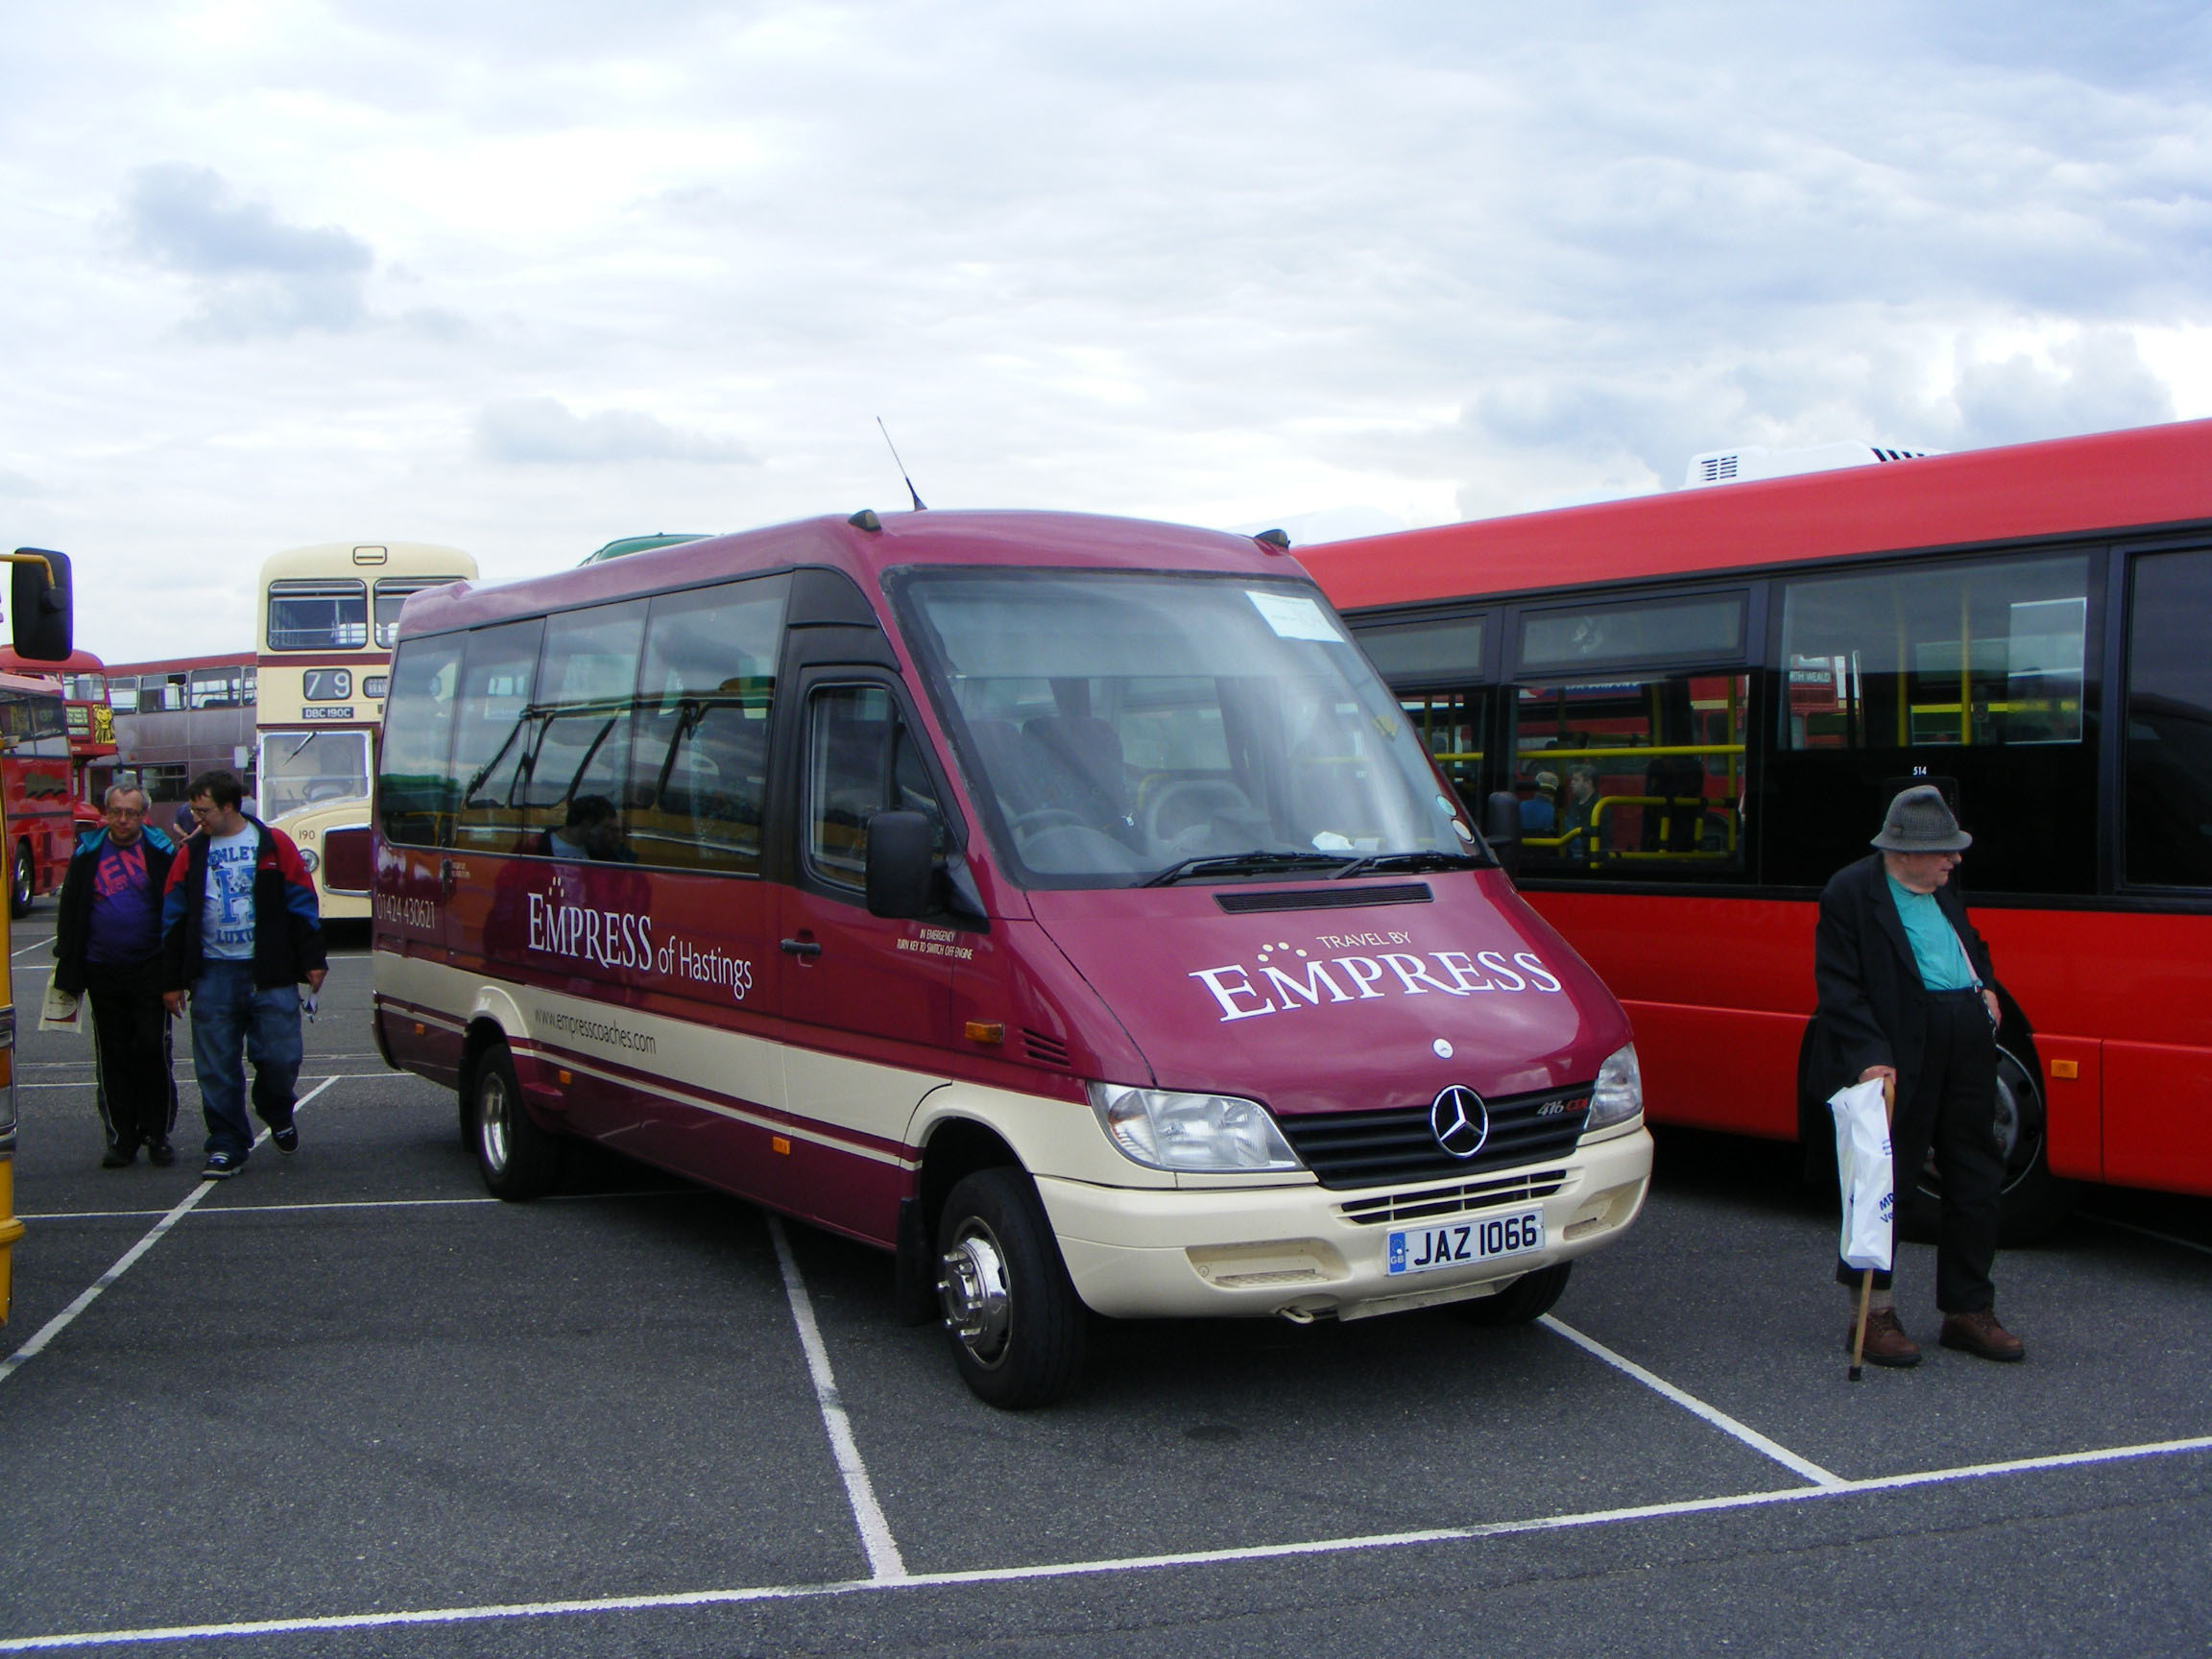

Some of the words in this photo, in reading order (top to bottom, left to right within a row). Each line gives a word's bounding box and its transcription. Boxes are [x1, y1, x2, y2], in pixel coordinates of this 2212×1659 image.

[306, 671, 350, 698] 79
[1912, 766, 1927, 776] 514
[299, 830, 315, 840] 190
[376, 893, 401, 923] 01424
[403, 897, 435, 928] 430621
[926, 929, 955, 942] EMERGENCY
[1316, 931, 1389, 950] TRAVEL
[1388, 931, 1412, 946] BY
[527, 892, 653, 971] EMPRESS
[658, 935, 676, 974] of
[680, 941, 753, 1000] Hastings
[909, 940, 919, 951] KEY
[945, 945, 954, 956] OFF
[1188, 950, 1563, 1022] EMPRESS
[534, 1006, 657, 1054] www.empresscoaches.com
[1537, 1101, 1564, 1116] 416
[1413, 1226, 1471, 1265] JAZ
[1479, 1214, 1537, 1256] 1066
[1390, 1254, 1405, 1264] GB
